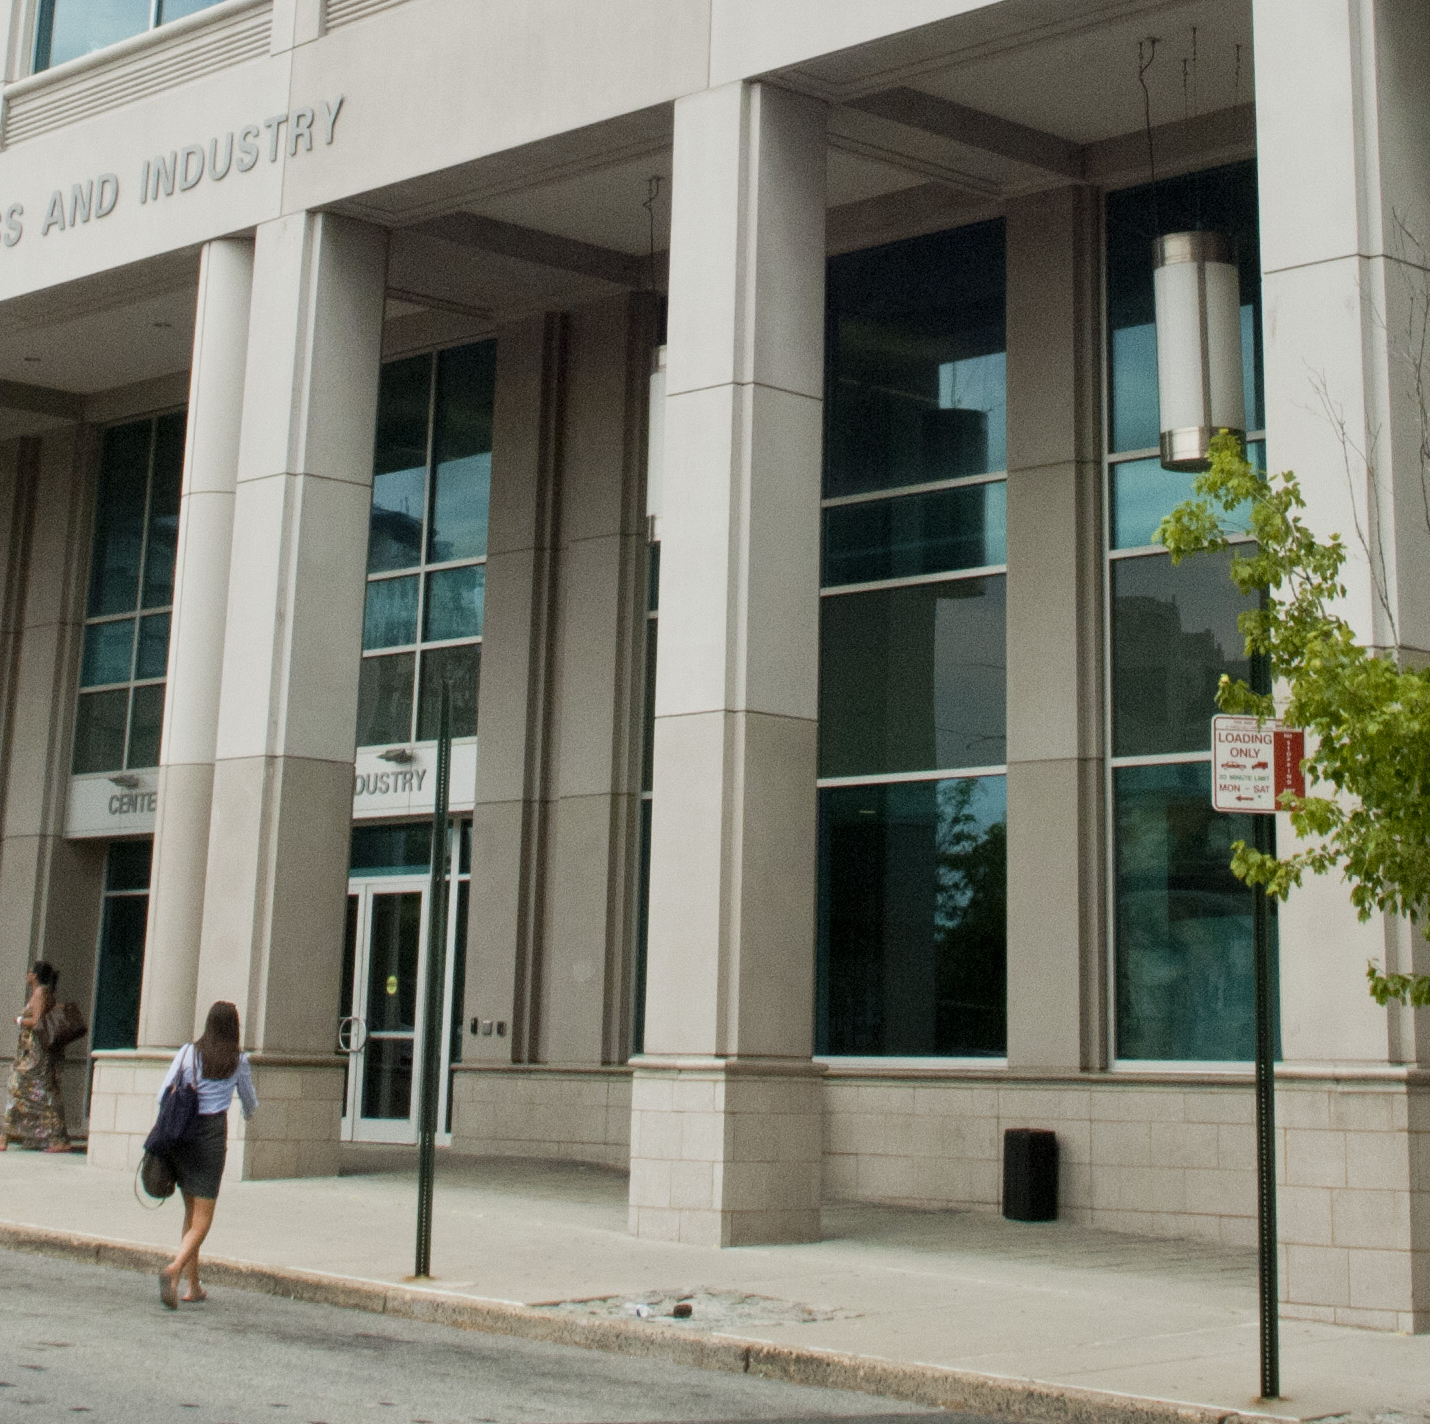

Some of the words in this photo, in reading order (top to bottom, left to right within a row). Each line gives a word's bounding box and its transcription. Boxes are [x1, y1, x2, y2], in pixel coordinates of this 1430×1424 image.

[41, 172, 120, 237] AND
[138, 94, 347, 204] INDUSTRY
[1218, 733, 1272, 744] LOADING
[1230, 747, 1260, 758] ONLY
[108, 791, 157, 816] CENTE
[354, 768, 427, 796] DUSTRY
[1219, 783, 1241, 792] MON
[1253, 784, 1270, 793] SAT
